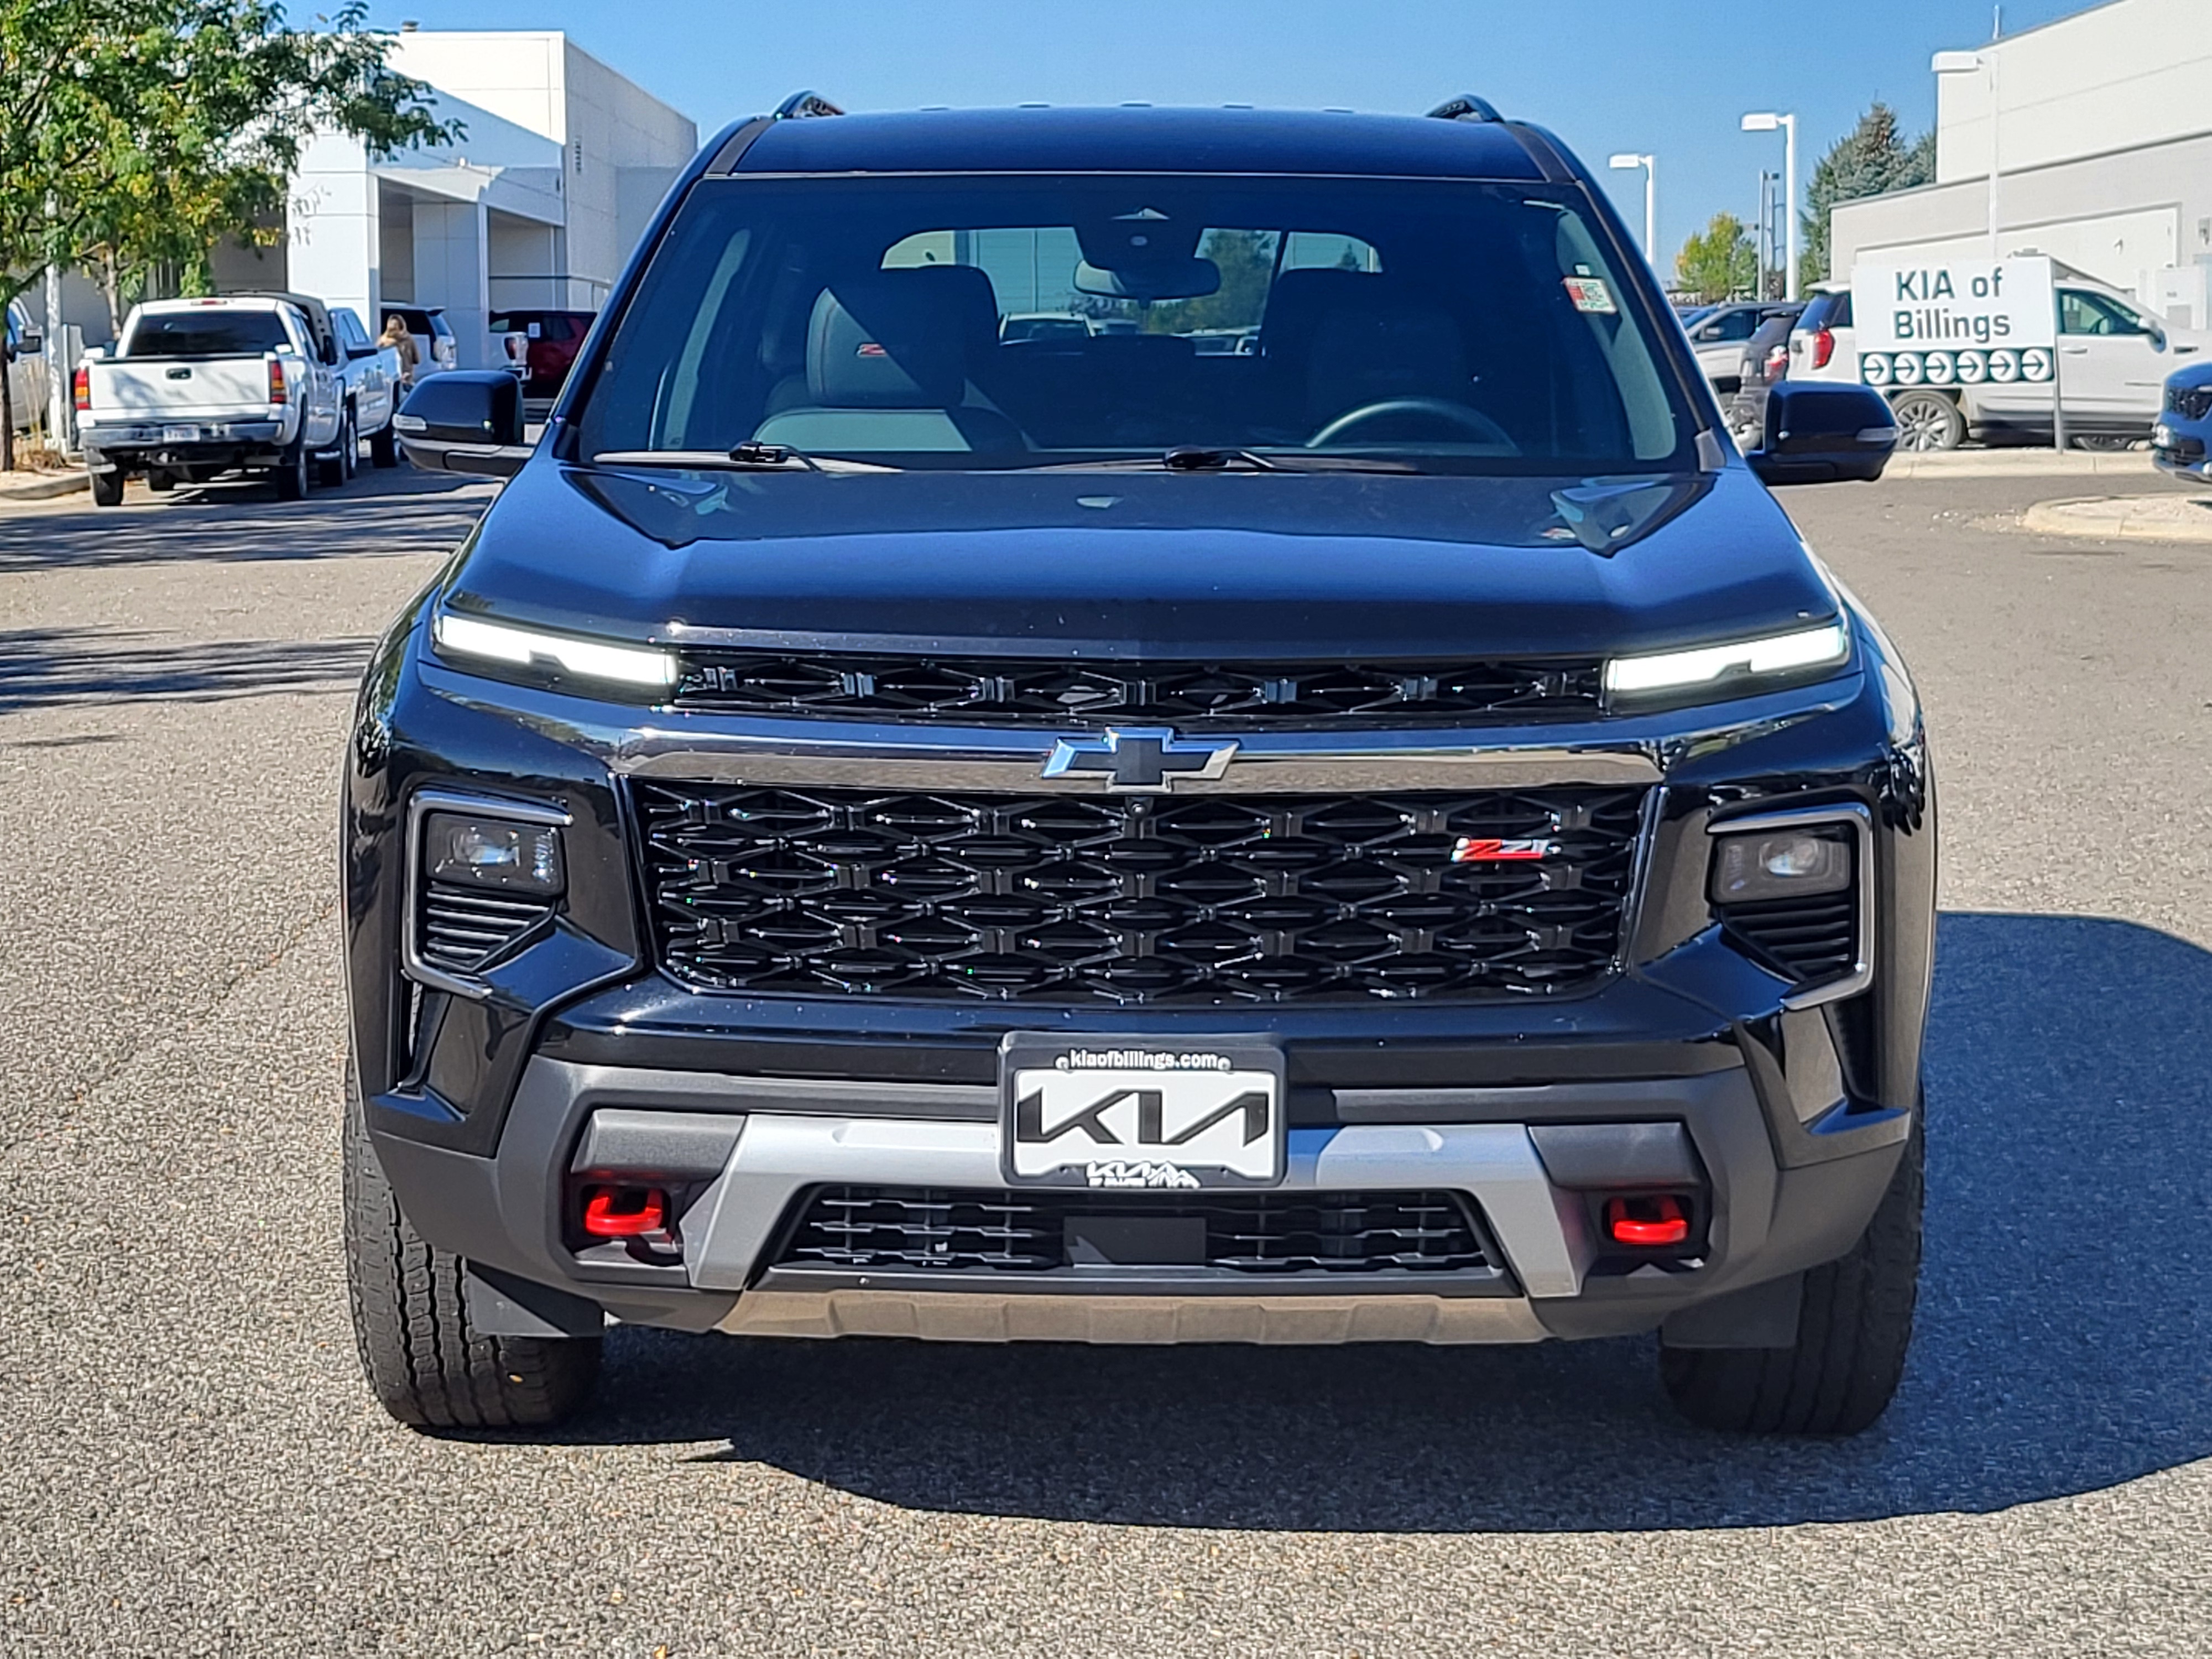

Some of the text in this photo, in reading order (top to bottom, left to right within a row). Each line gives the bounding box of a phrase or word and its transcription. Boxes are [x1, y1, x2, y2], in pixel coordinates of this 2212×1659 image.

[1895, 266, 2003, 301] KIA of
[1893, 307, 2011, 344] Billings
[1070, 1049, 1219, 1070] kiaofbillings.com
[1016, 1089, 1270, 1146] KIA
